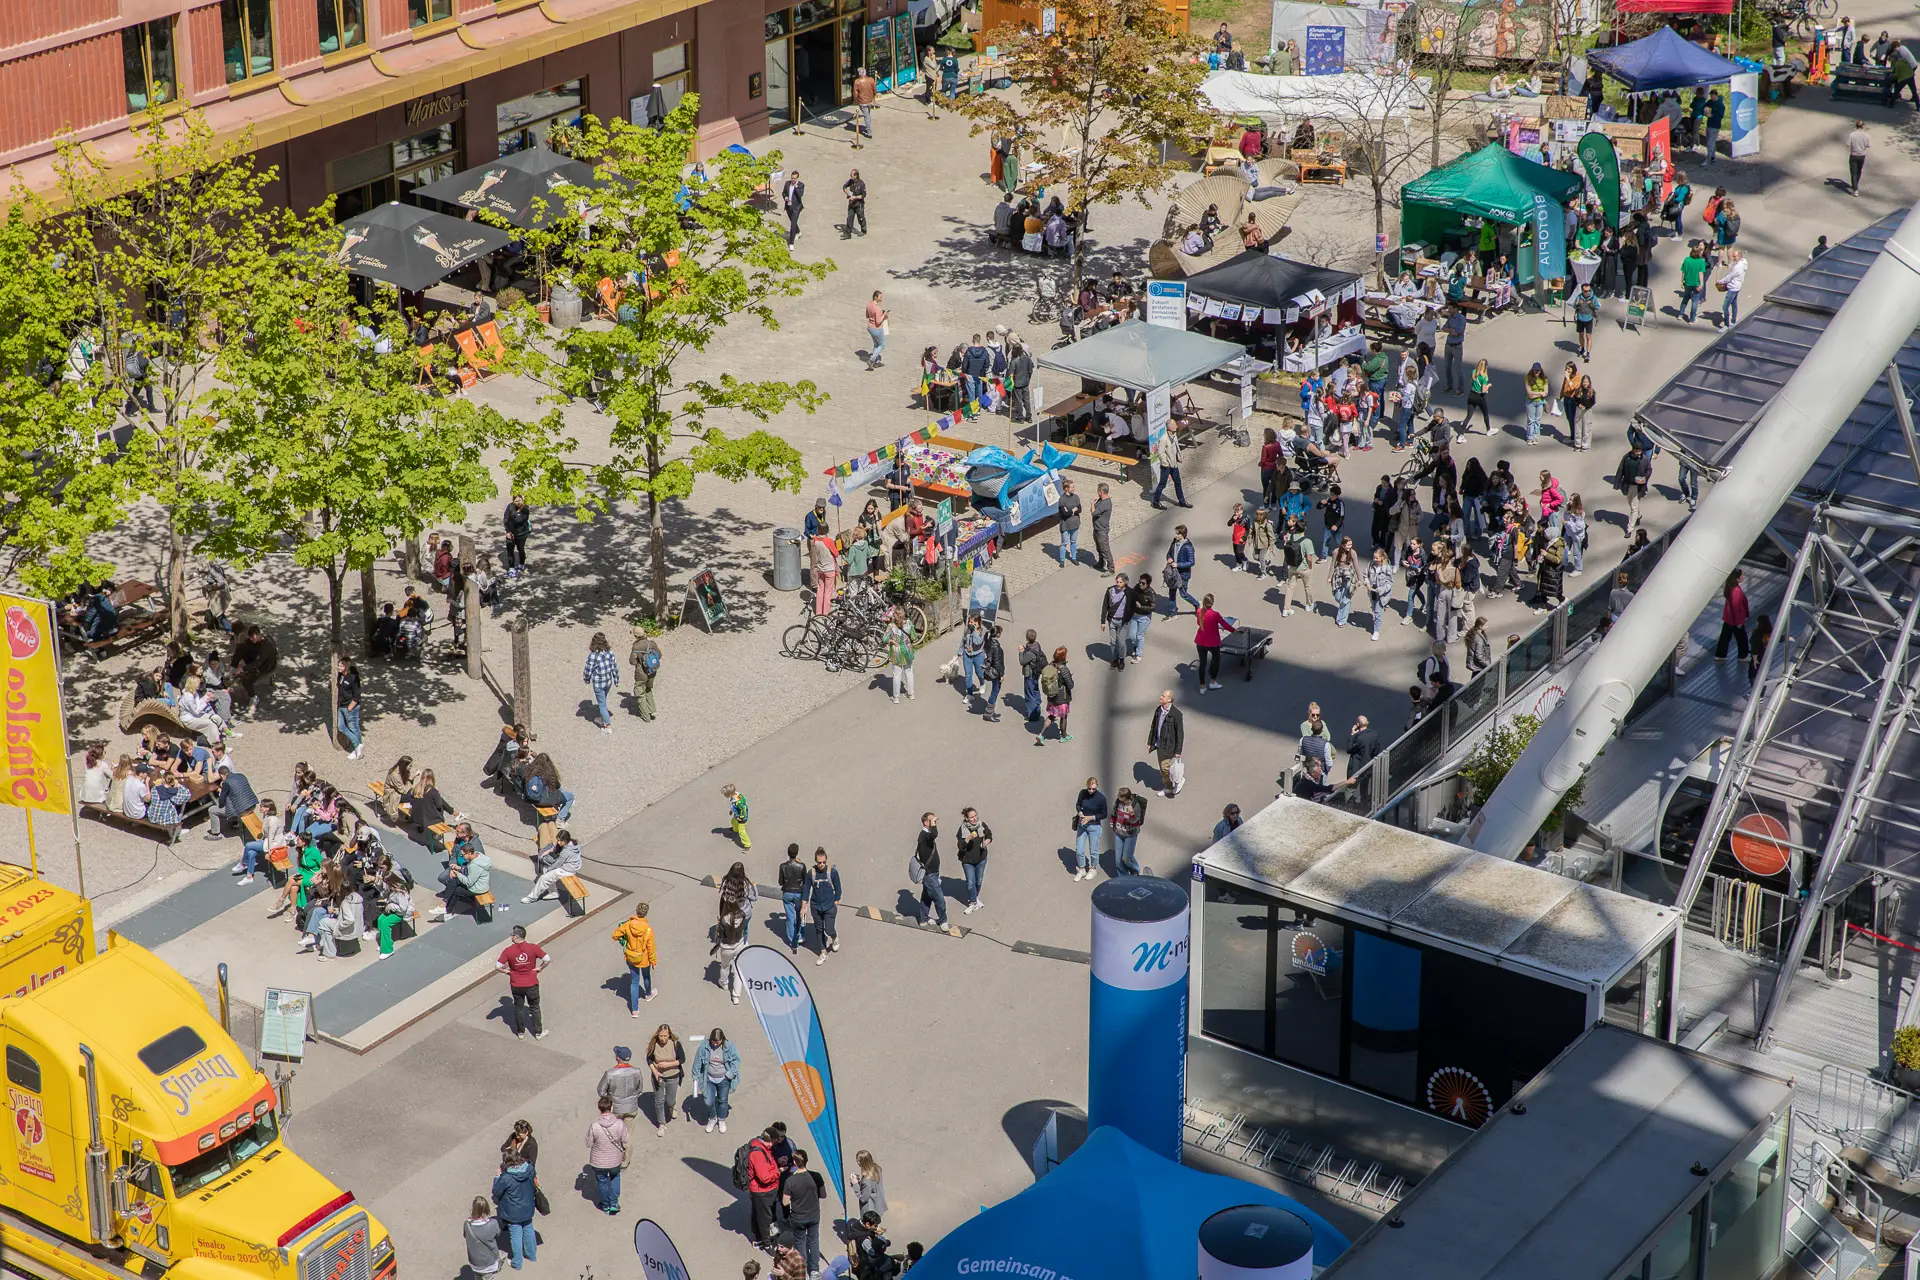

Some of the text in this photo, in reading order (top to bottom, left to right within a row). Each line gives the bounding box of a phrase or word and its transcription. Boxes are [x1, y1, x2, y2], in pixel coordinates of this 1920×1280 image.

[453, 100, 468, 110] BAR
[1488, 208, 1506, 218] AOK
[6, 889, 54, 916] 2023
[1177, 995, 1186, 1055] erleben
[160, 1054, 239, 1116] Sinalco
[1176, 1060, 1184, 1100] mehr
[9, 1088, 43, 1117] Sinalco
[194, 1248, 259, 1263] Truck-Tour 2023
[198, 1238, 225, 1250] Sinalco
[957, 1256, 1056, 1280] Gemeinsam
